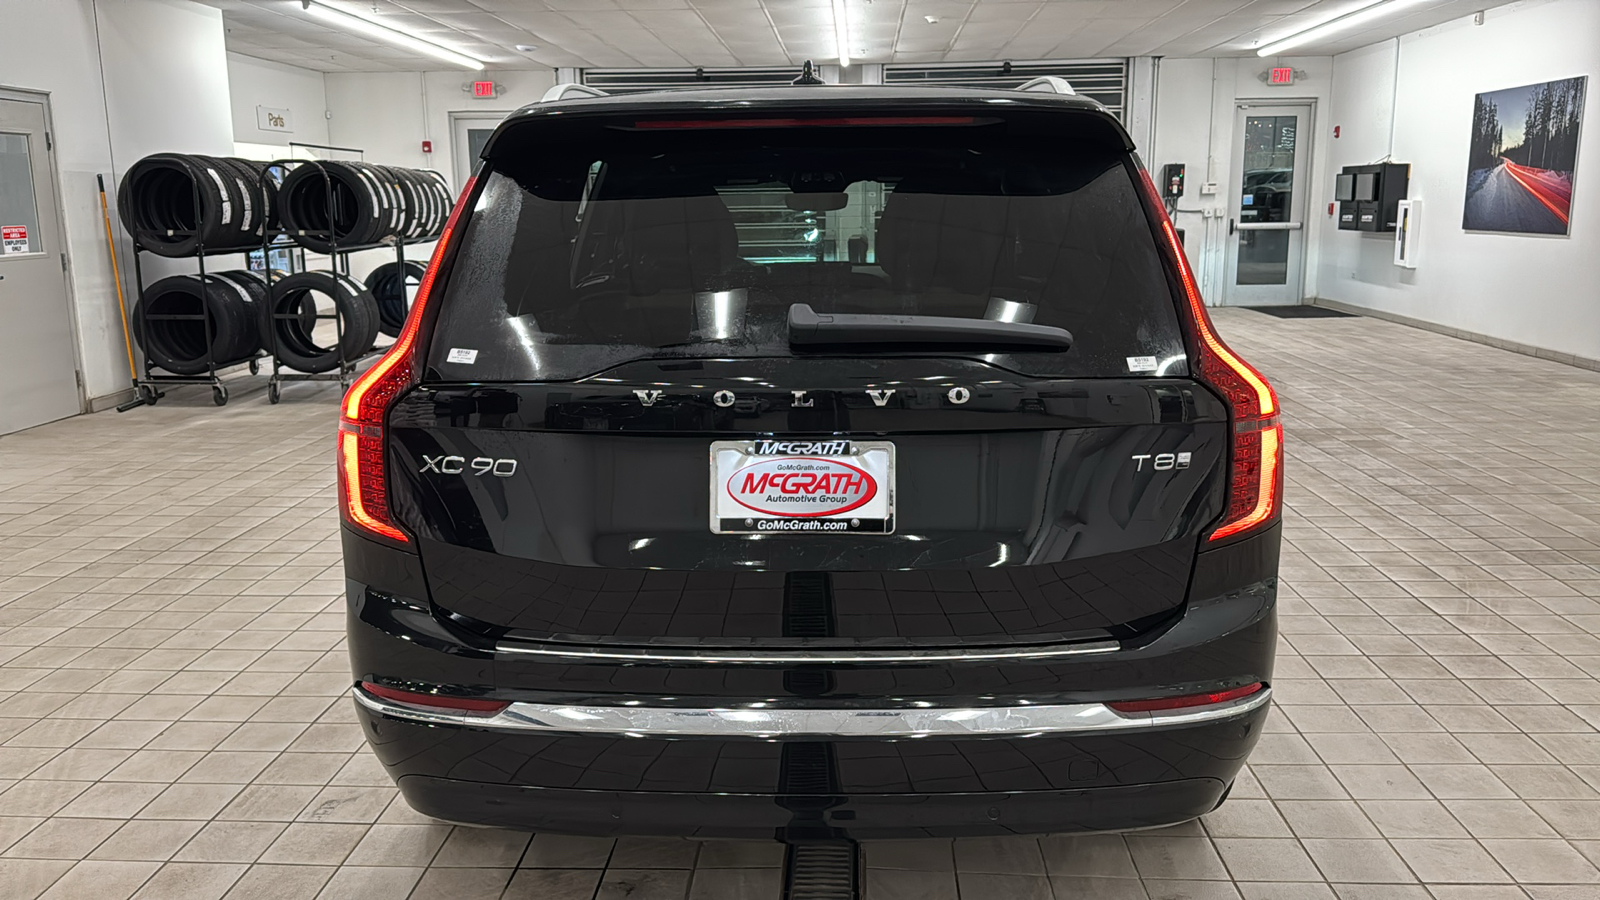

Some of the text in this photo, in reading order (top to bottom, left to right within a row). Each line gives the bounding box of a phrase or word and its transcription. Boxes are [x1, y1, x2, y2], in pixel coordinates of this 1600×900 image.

[1272, 67, 1292, 83] EXIT
[474, 81, 493, 96] EXIT
[267, 112, 285, 128] Parts
[632, 387, 971, 408] VOLVO
[765, 494, 847, 504] Automotive Group
[757, 520, 847, 530] GoMcGrath.com
